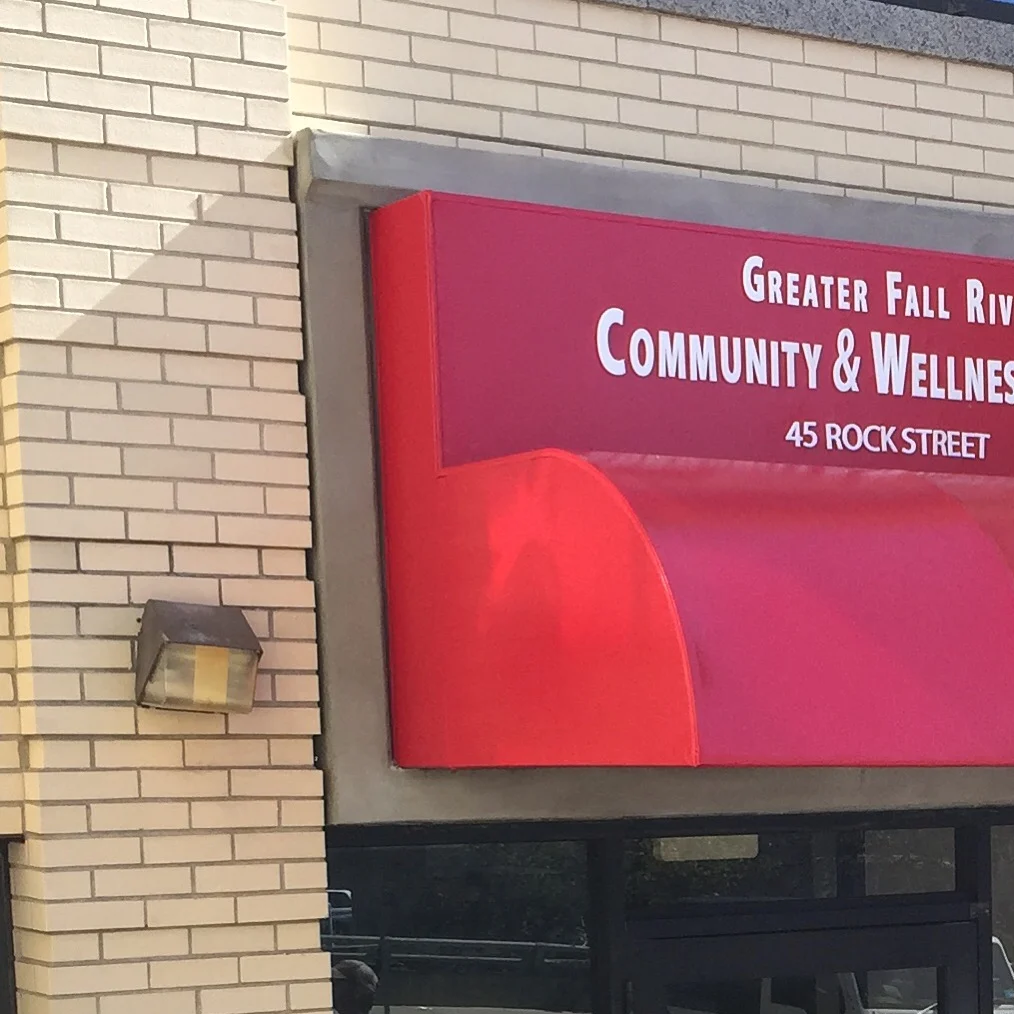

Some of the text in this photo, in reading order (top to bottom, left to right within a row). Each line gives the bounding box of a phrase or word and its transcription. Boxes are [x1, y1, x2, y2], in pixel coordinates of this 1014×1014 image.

[742, 255, 868, 313] GREATER
[886, 271, 950, 320] FALL
[596, 307, 822, 390] COMMUNITY
[833, 328, 860, 393] &
[785, 421, 990, 460] 45 ROCK STREET
